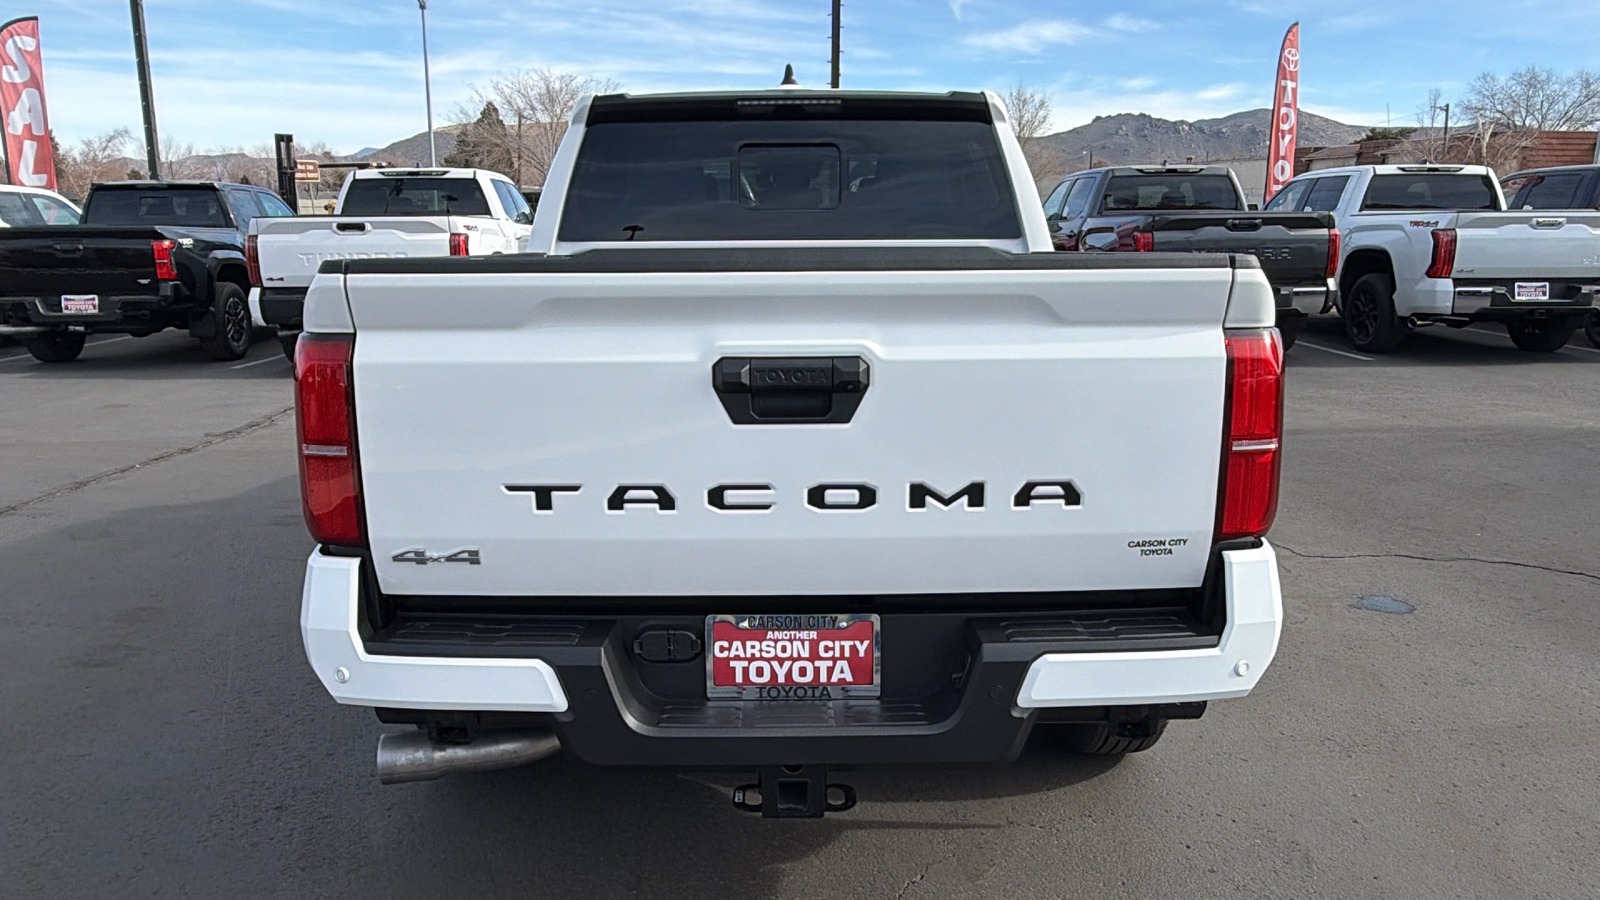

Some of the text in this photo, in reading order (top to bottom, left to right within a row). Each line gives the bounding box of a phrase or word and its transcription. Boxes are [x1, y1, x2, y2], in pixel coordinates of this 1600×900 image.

[2, 35, 48, 187] SAL
[1272, 80, 1297, 190] TOYO
[754, 369, 829, 383] TOYOTA
[501, 480, 1082, 513] TACOMA
[1127, 538, 1188, 548] CARSON CITY
[1140, 548, 1173, 556] TOYOTA
[748, 615, 838, 629] CARSON CITY
[766, 631, 817, 640] ANOTHER
[713, 640, 870, 658] CARSON CITY
[729, 660, 853, 683] TOYOTA
[755, 686, 831, 699] TOYOTA
